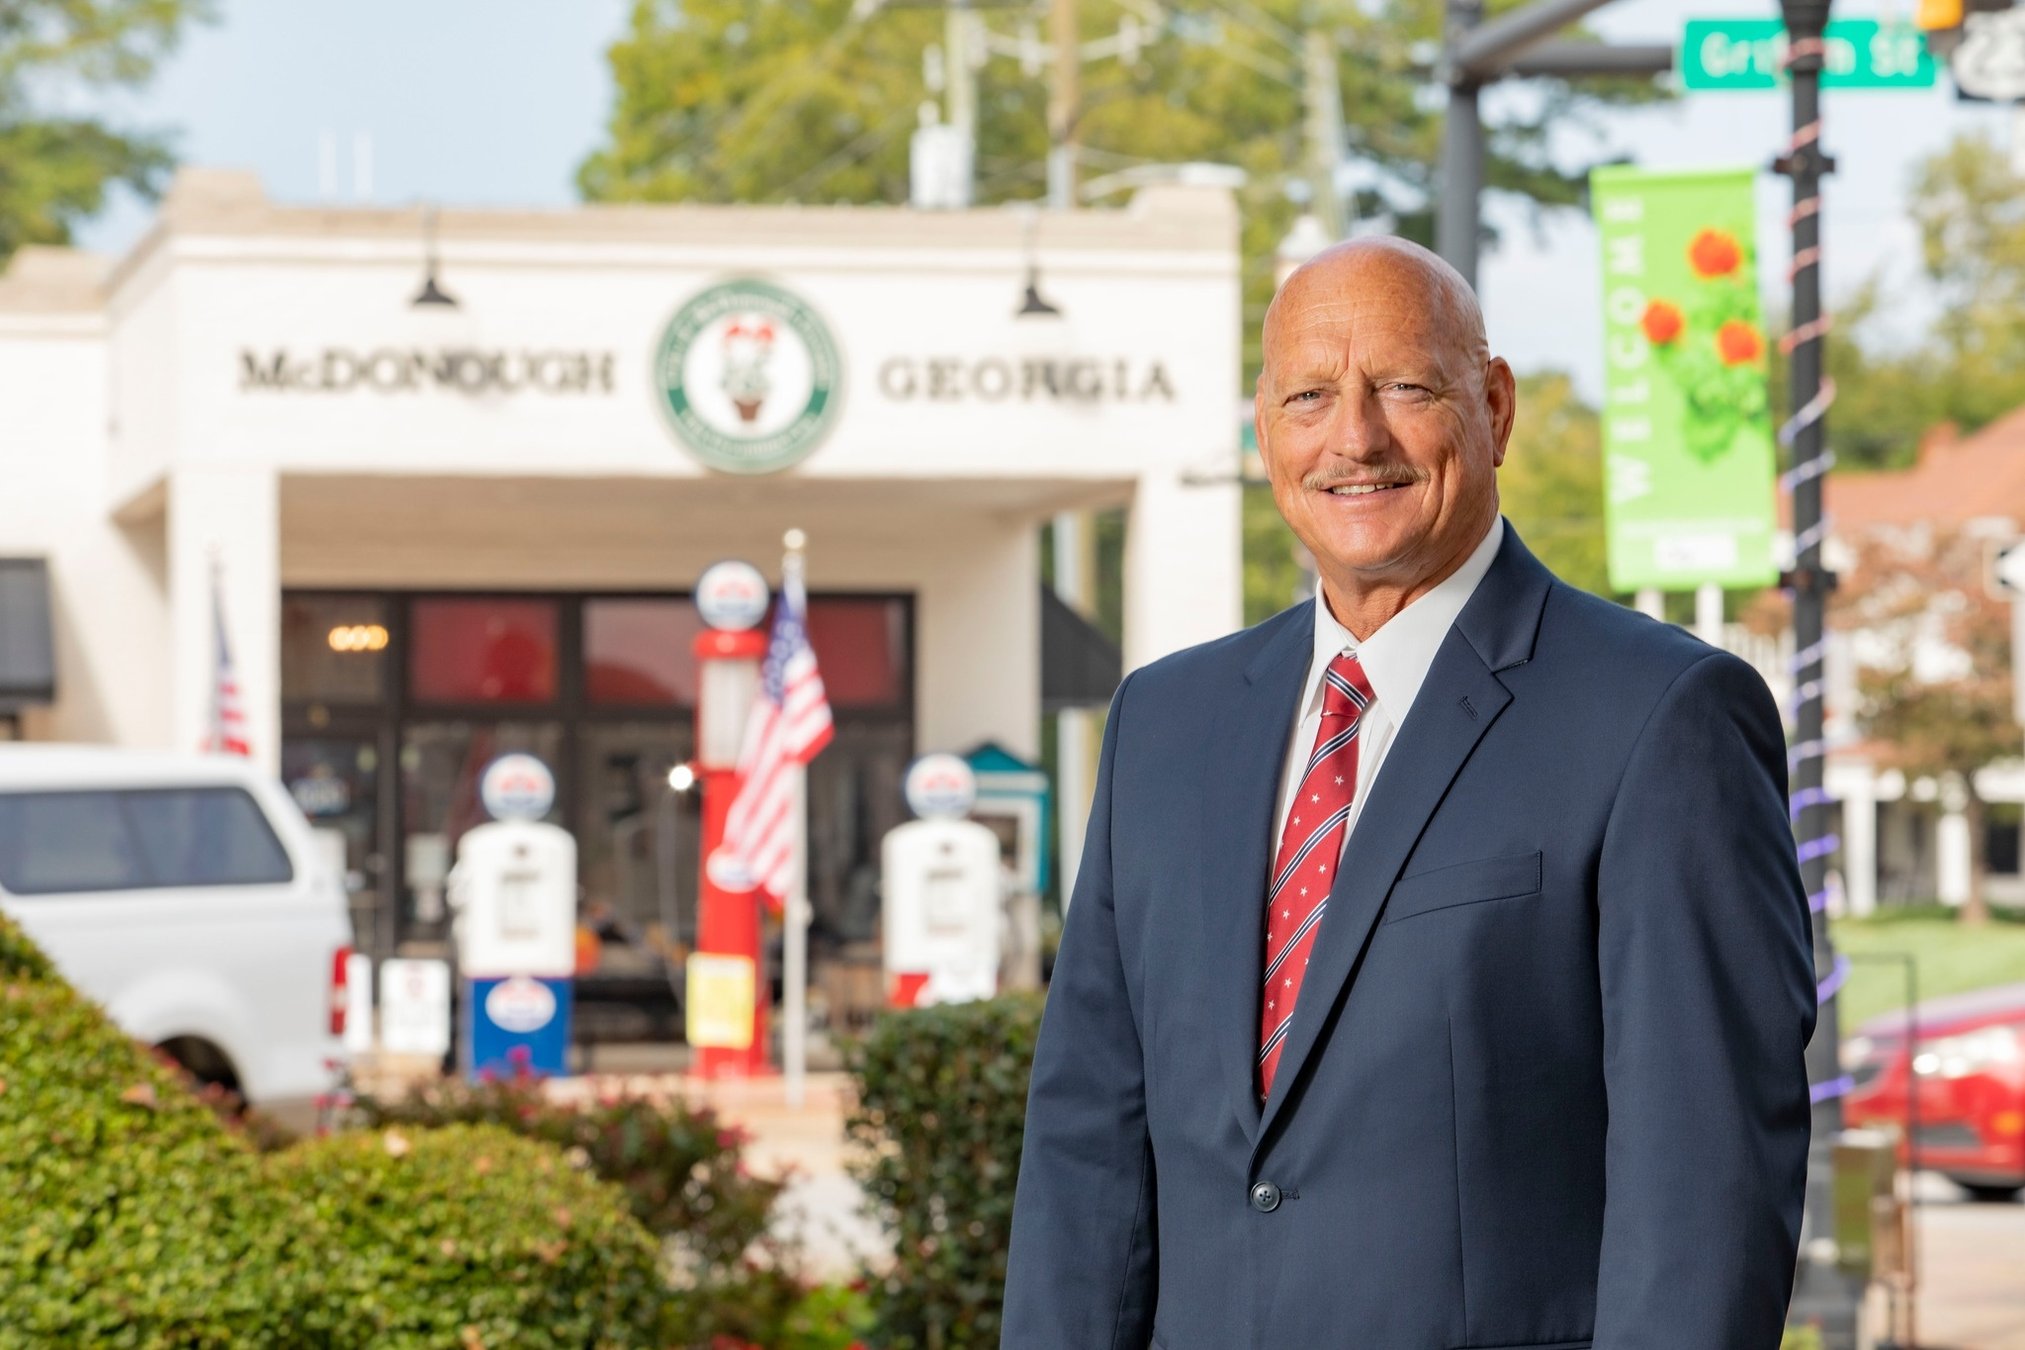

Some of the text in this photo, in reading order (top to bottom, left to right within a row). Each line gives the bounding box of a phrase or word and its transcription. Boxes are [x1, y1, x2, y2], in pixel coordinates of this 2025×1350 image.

[240, 347, 1176, 402] McDONOUGH GEORGIA
[1604, 198, 1652, 504] WELCOME
